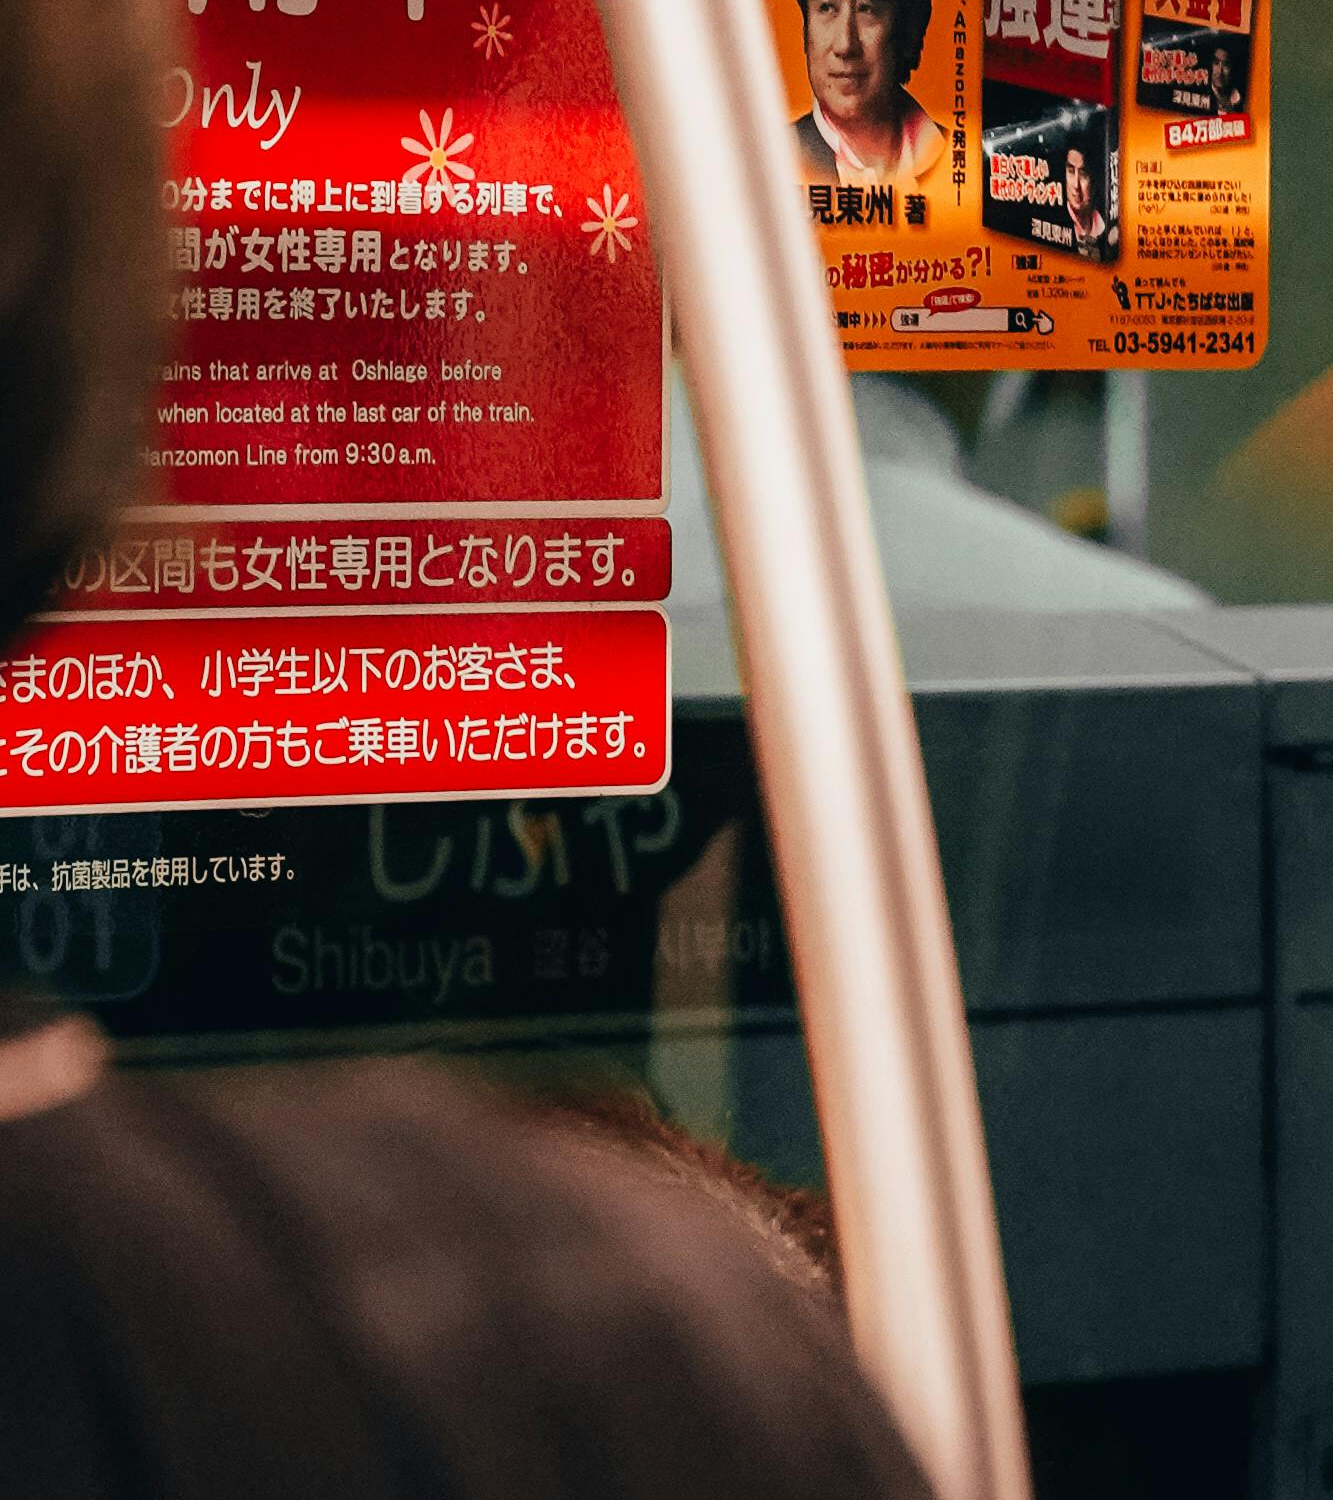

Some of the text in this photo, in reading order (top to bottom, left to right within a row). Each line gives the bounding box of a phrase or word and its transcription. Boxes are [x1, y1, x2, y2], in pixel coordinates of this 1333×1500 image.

[1088, 330, 1255, 354] TEL 03-5941-2341
[154, 359, 502, 383] ains that arrive at Oshiage before
[158, 400, 535, 424] when located at the last car of the train.
[247, 443, 287, 465] Line
[294, 443, 338, 465] from
[270, 922, 496, 1005] Shibuya
